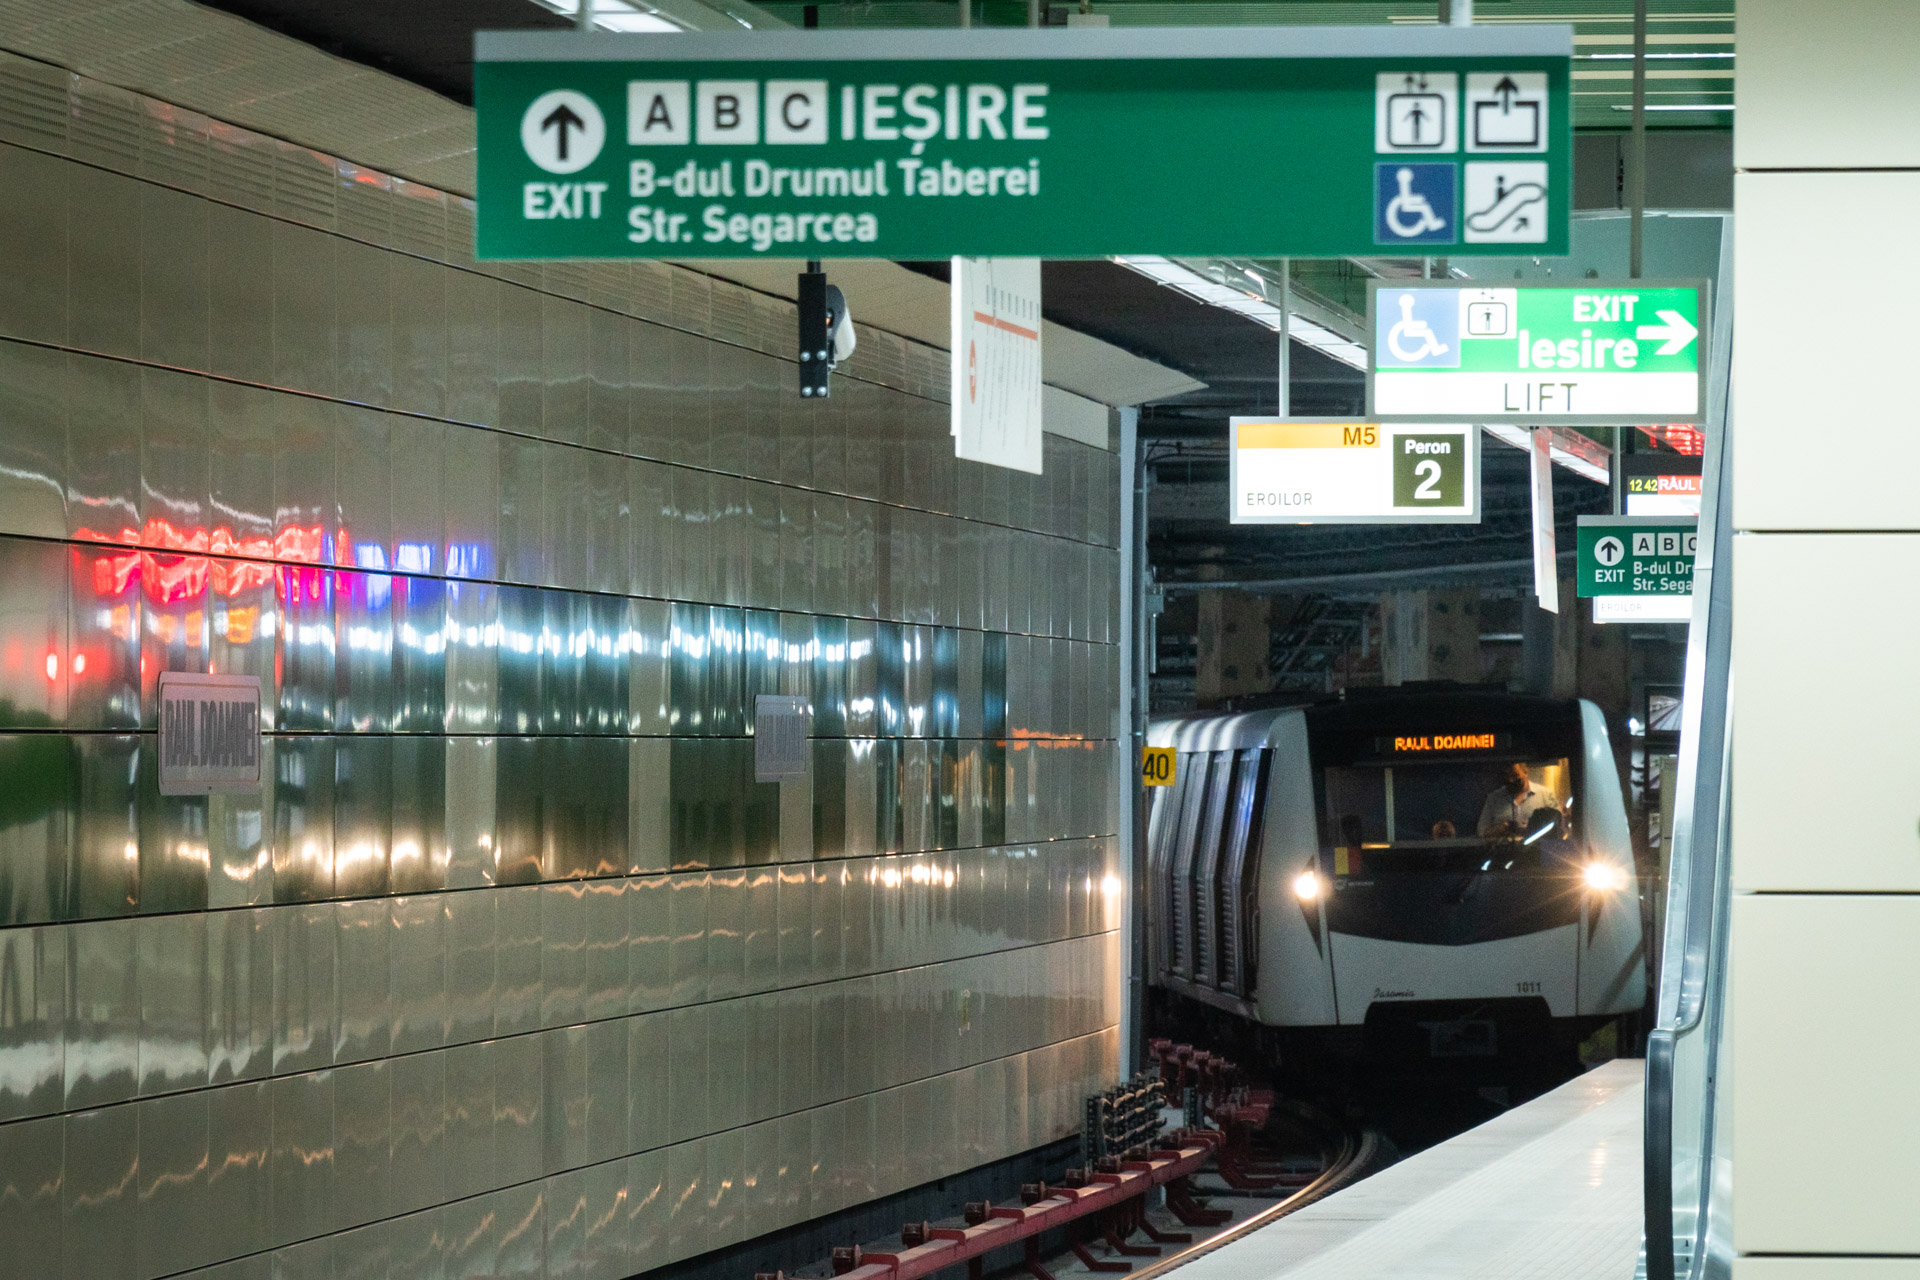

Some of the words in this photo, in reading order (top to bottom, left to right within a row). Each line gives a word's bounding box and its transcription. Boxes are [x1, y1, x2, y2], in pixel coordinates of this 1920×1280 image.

[644, 94, 673, 132] A
[714, 95, 740, 131] B
[782, 94, 811, 131] C
[841, 83, 1049, 156] IEȘIRE
[629, 159, 734, 198] B-dul
[745, 159, 888, 198] Drumul
[897, 158, 1040, 198] Taberei
[523, 182, 608, 220] EXIT
[628, 205, 693, 244] Str.
[702, 205, 878, 252] Segarcea
[1573, 295, 1639, 322] EXIT
[1518, 329, 1639, 368] Iesire
[1504, 383, 1578, 412] LIFT
[1343, 427, 1376, 446] M5
[1404, 439, 1451, 454] Peron
[1414, 459, 1442, 499] 2
[1247, 493, 1312, 506] EROILOR
[1638, 537, 1650, 551] A
[1663, 537, 1675, 551] B
[1594, 569, 1625, 583] EXIT
[1633, 561, 1671, 575] B-dul
[1633, 577, 1656, 591] Str.
[1434, 734, 1495, 750] DOAMNEI
[1142, 753, 1169, 780] 40
[1516, 982, 1542, 993] 1011
